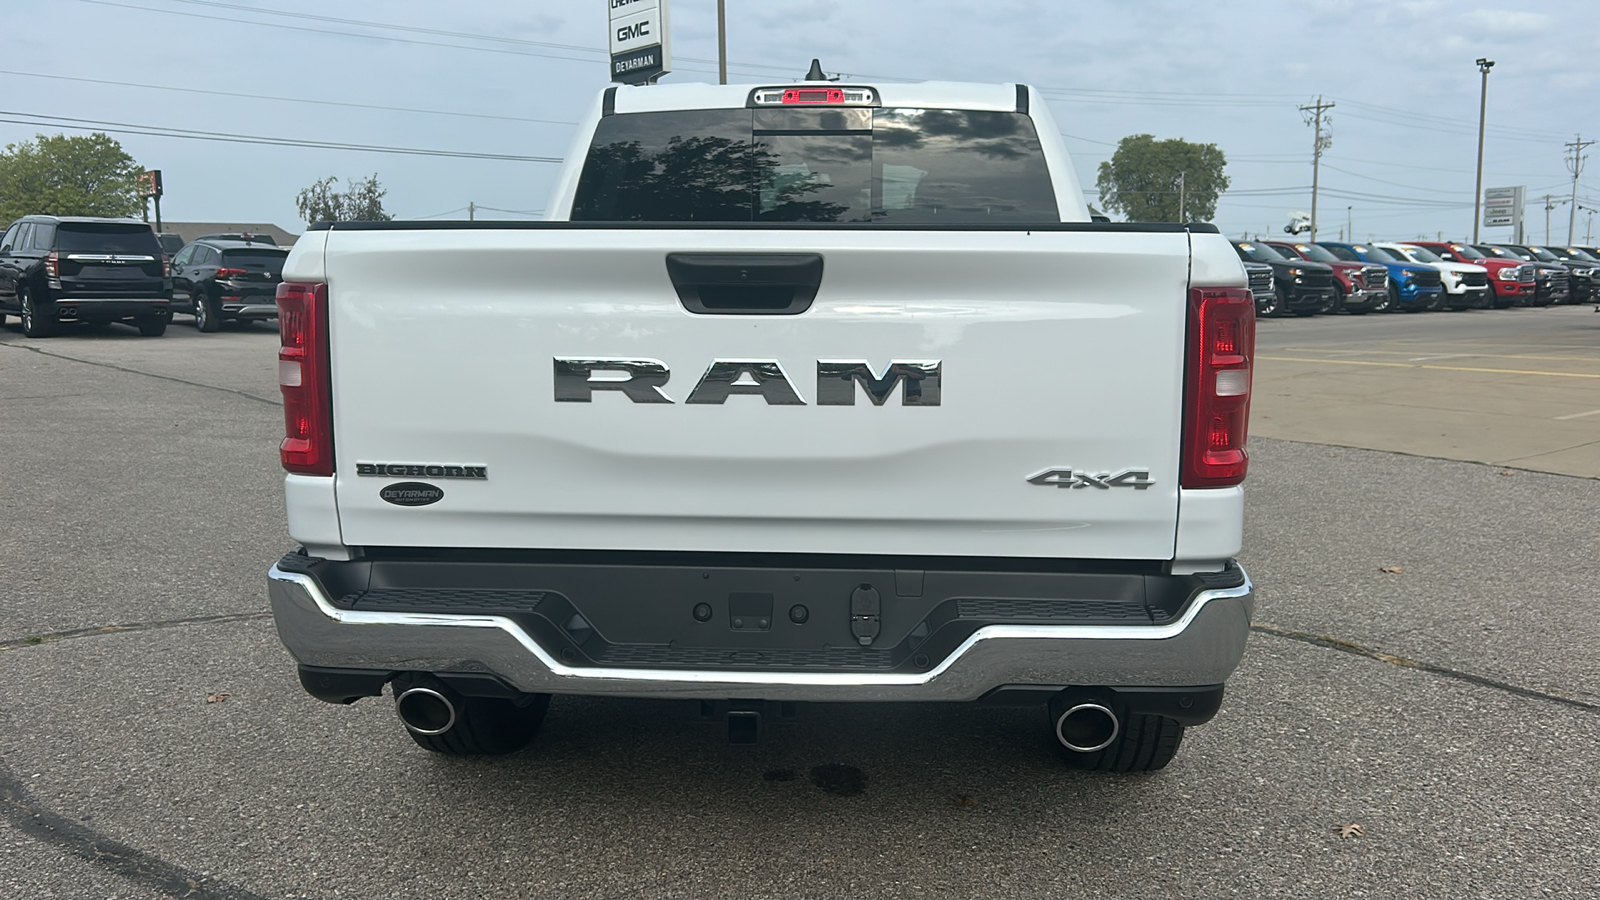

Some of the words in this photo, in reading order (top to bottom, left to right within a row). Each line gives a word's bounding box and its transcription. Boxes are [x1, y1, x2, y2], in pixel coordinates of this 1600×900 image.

[617, 20, 649, 42] GMC
[615, 54, 654, 73] DEYARMAN
[552, 355, 943, 407] RAM
[356, 462, 488, 480] BIGHORN
[1025, 466, 1157, 490] 4x4
[384, 489, 440, 498] DEYARMAN
